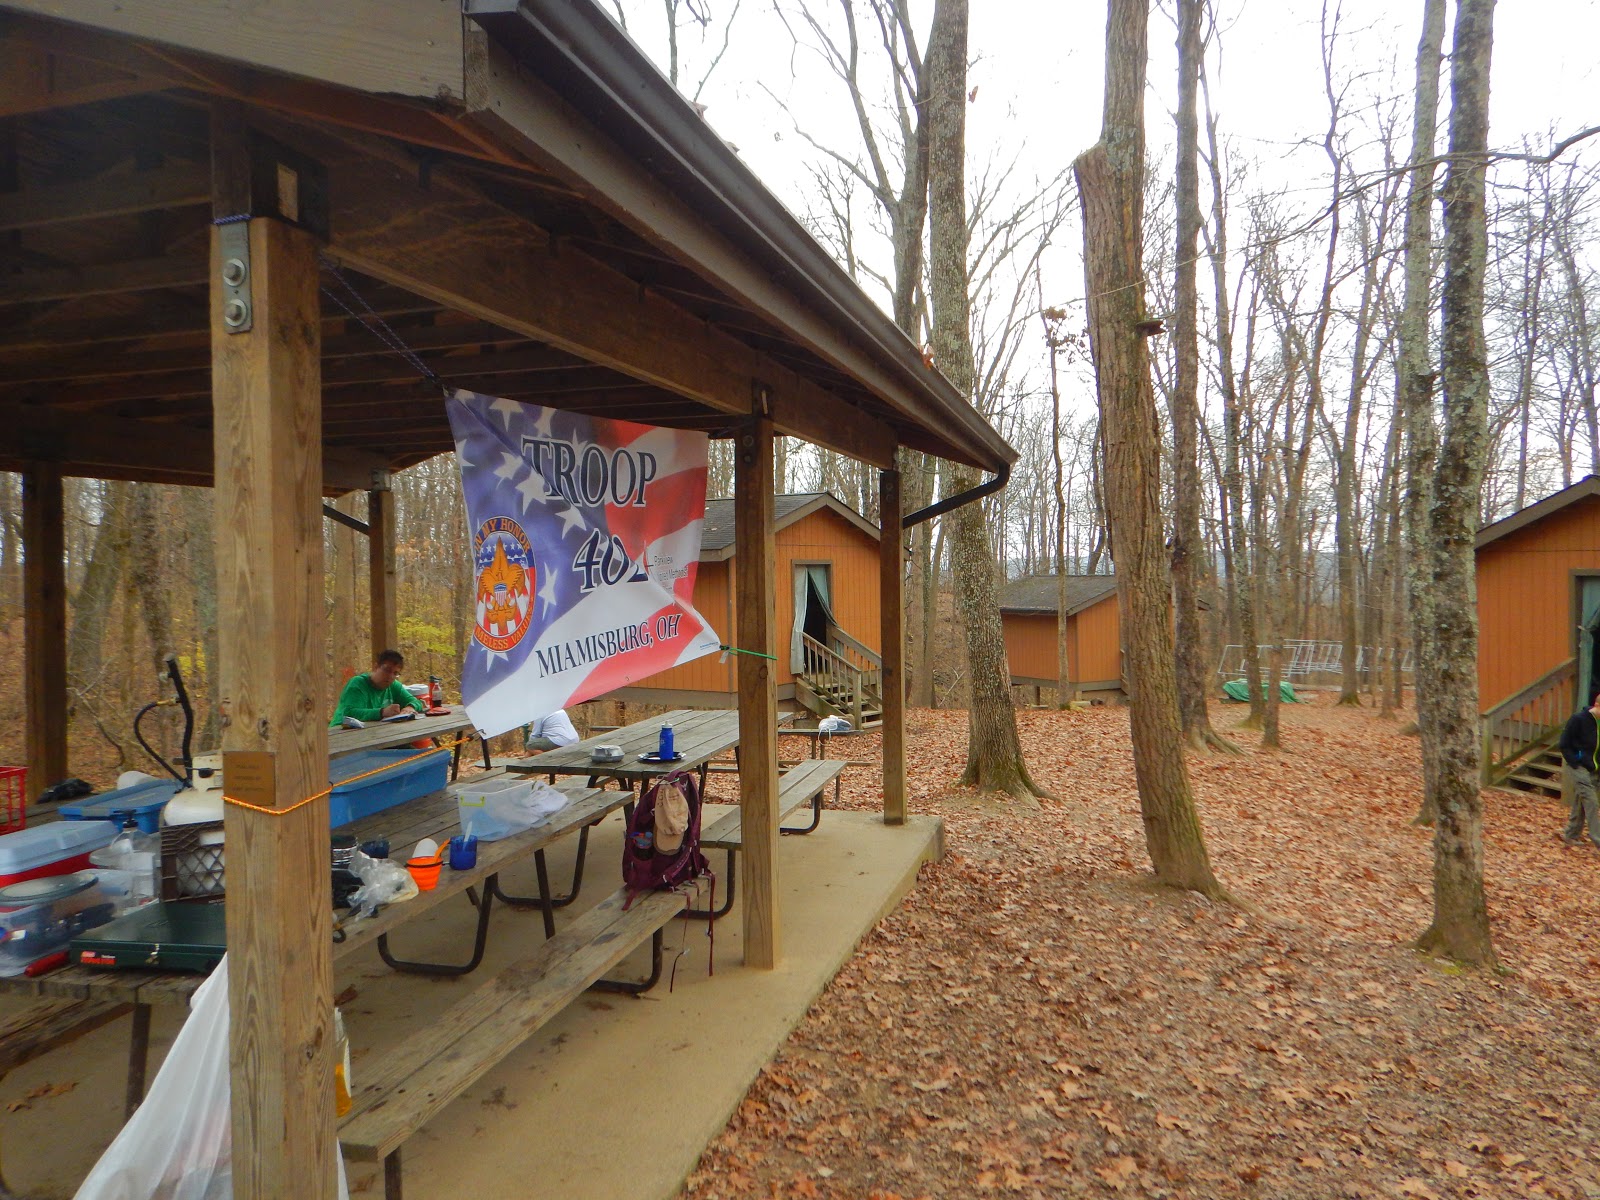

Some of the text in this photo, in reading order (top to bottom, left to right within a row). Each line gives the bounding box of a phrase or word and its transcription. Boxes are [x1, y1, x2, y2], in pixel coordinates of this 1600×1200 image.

[521, 434, 657, 507] TROOP
[482, 519, 498, 538] MY
[500, 518, 531, 553] HONOR
[535, 613, 682, 678] MIAMISBURG, OH
